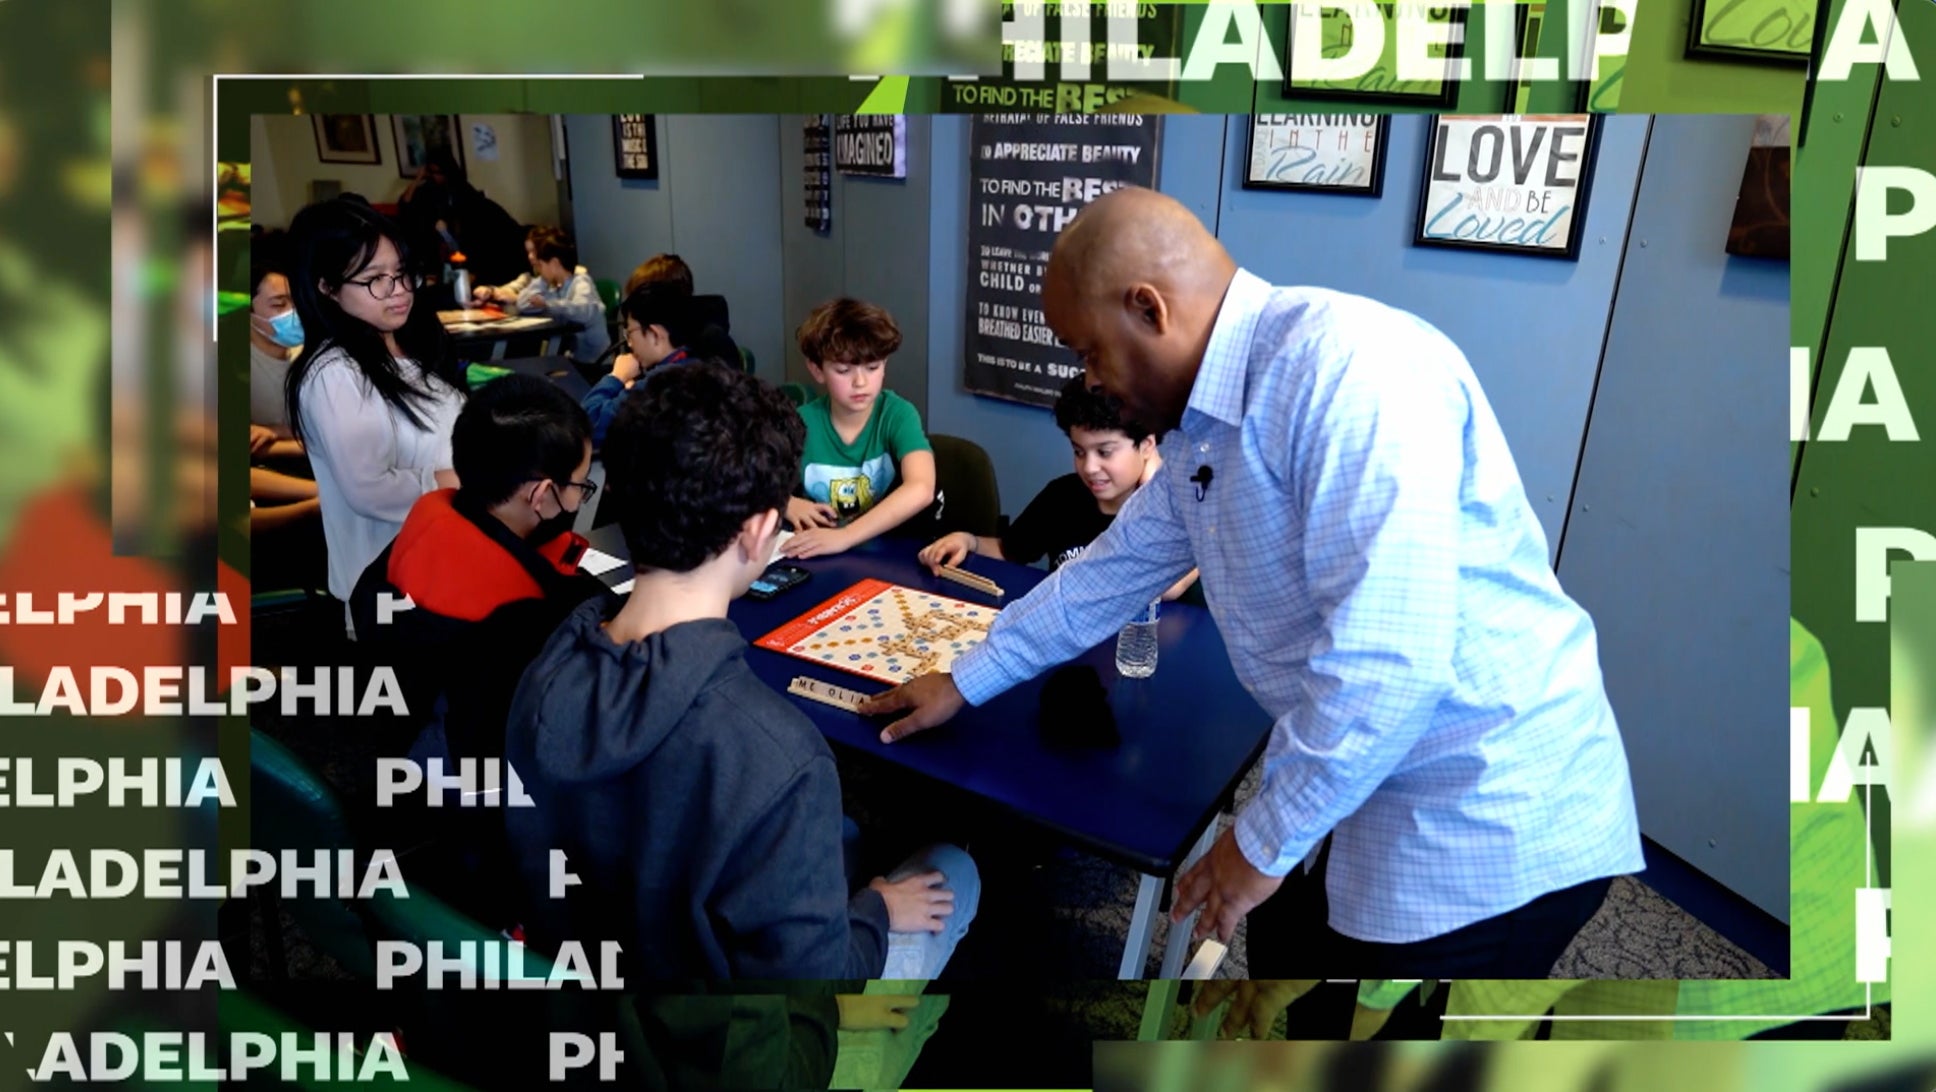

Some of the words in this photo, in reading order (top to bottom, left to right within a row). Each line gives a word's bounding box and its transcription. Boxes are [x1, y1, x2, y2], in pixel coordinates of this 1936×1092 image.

[953, 84, 977, 104] TO
[980, 86, 1017, 106] FIND
[1020, 88, 1054, 108] THE
[994, 142, 1077, 161] APPRECIATE
[1082, 145, 1141, 165] BEAUTY
[1266, 145, 1366, 184] Rain
[1433, 125, 1585, 187] LOVE
[980, 178, 999, 194] TO
[1001, 179, 1031, 197] FIND
[1033, 181, 1060, 198] THE
[1062, 176, 1127, 203] BES
[1463, 187, 1522, 212] AND
[1526, 190, 1551, 214] BE
[982, 203, 1004, 227] IN
[1013, 203, 1078, 232] OTH
[1425, 192, 1570, 244] Loved
[981, 259, 1031, 275] WHETHER
[980, 271, 1024, 292] CHILD
[979, 302, 990, 316] TO
[992, 304, 1019, 320] KNOW
[978, 317, 1021, 341] BREATHED
[1022, 324, 1054, 346] EASIER
[977, 353, 996, 365] THIS
[1006, 358, 1018, 369] TO
[1018, 361, 1031, 372] BE
[1033, 364, 1043, 374] A
